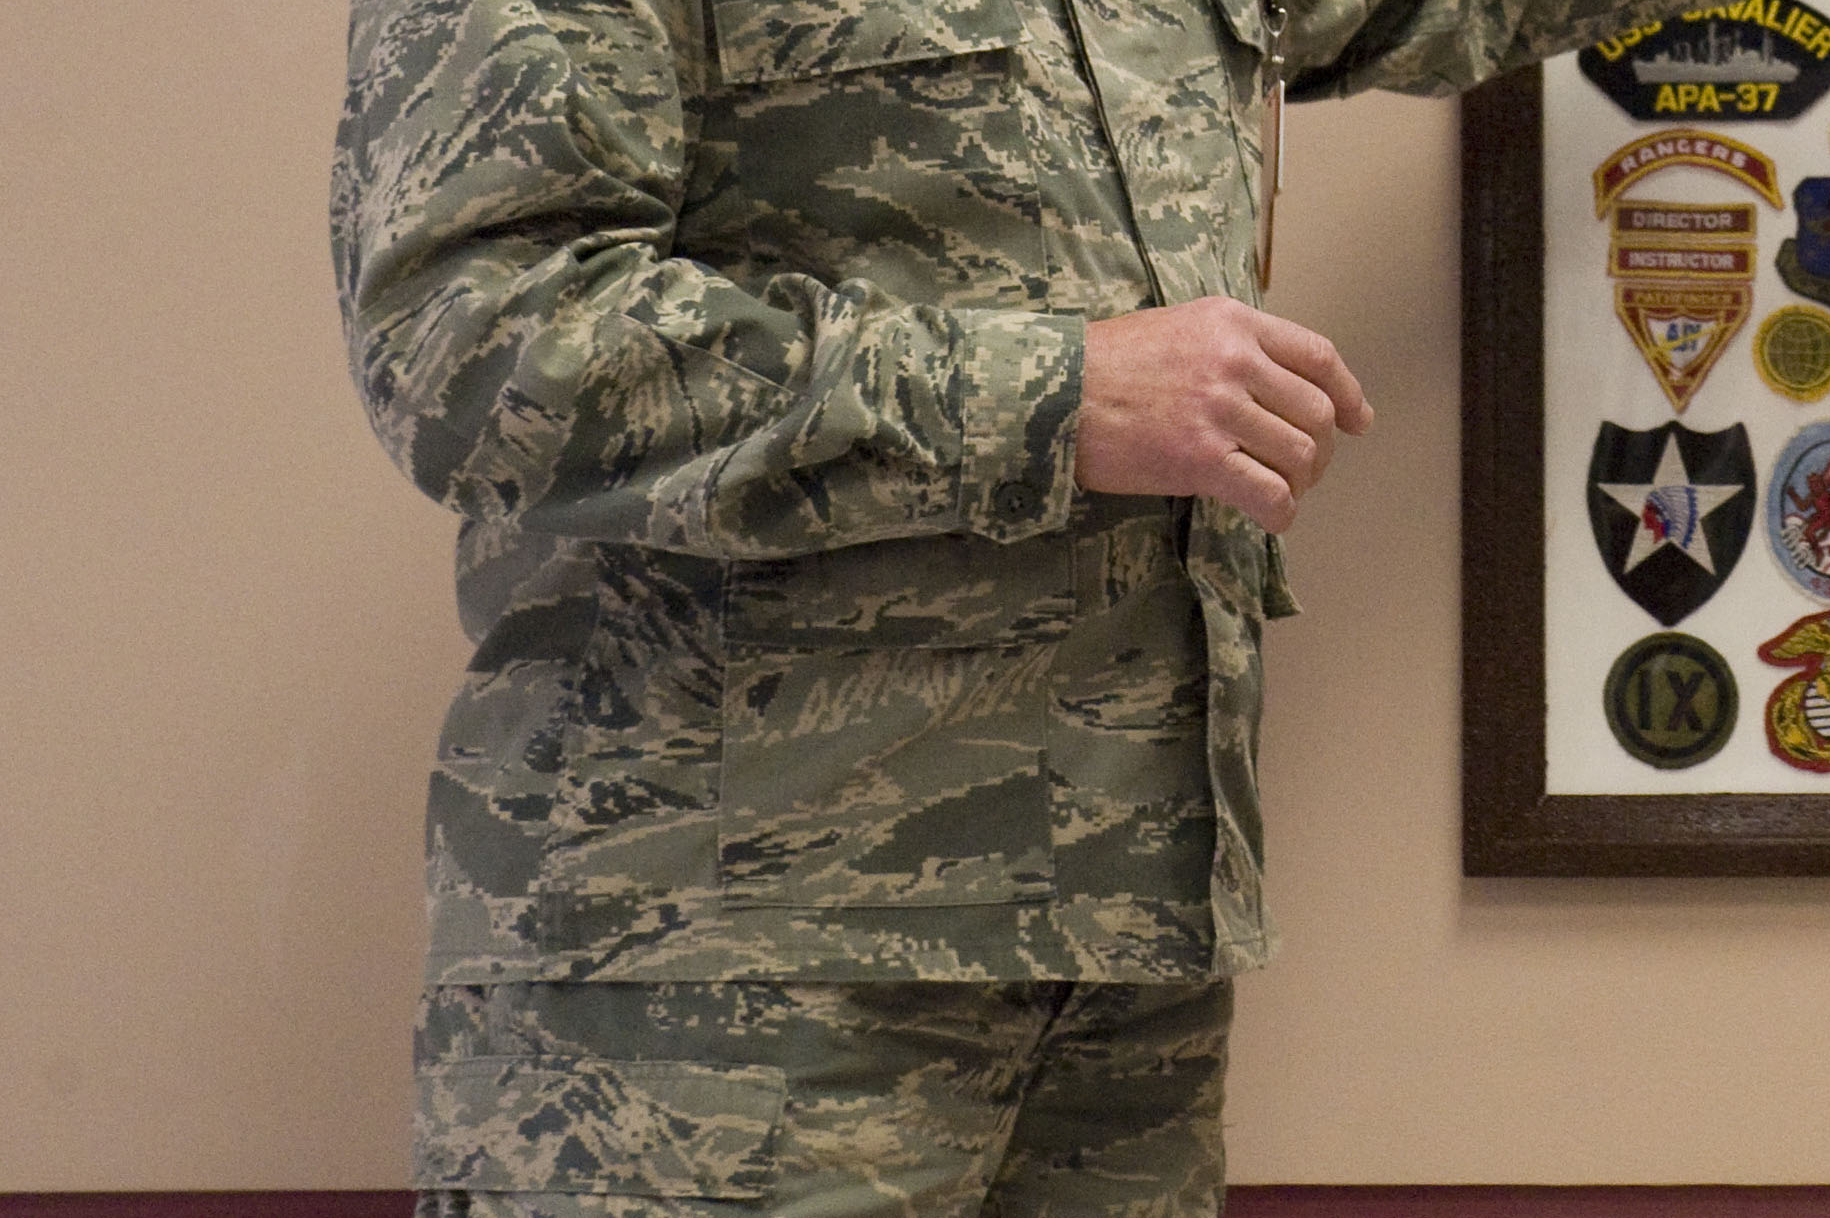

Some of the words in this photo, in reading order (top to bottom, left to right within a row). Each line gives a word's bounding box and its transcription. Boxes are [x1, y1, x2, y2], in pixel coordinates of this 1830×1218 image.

[1655, 83, 1780, 113] APA-37
[1620, 139, 1748, 173] RANGERS
[1632, 211, 1734, 229] DIRECTOR
[1628, 253, 1735, 270] INSTRUCTOR
